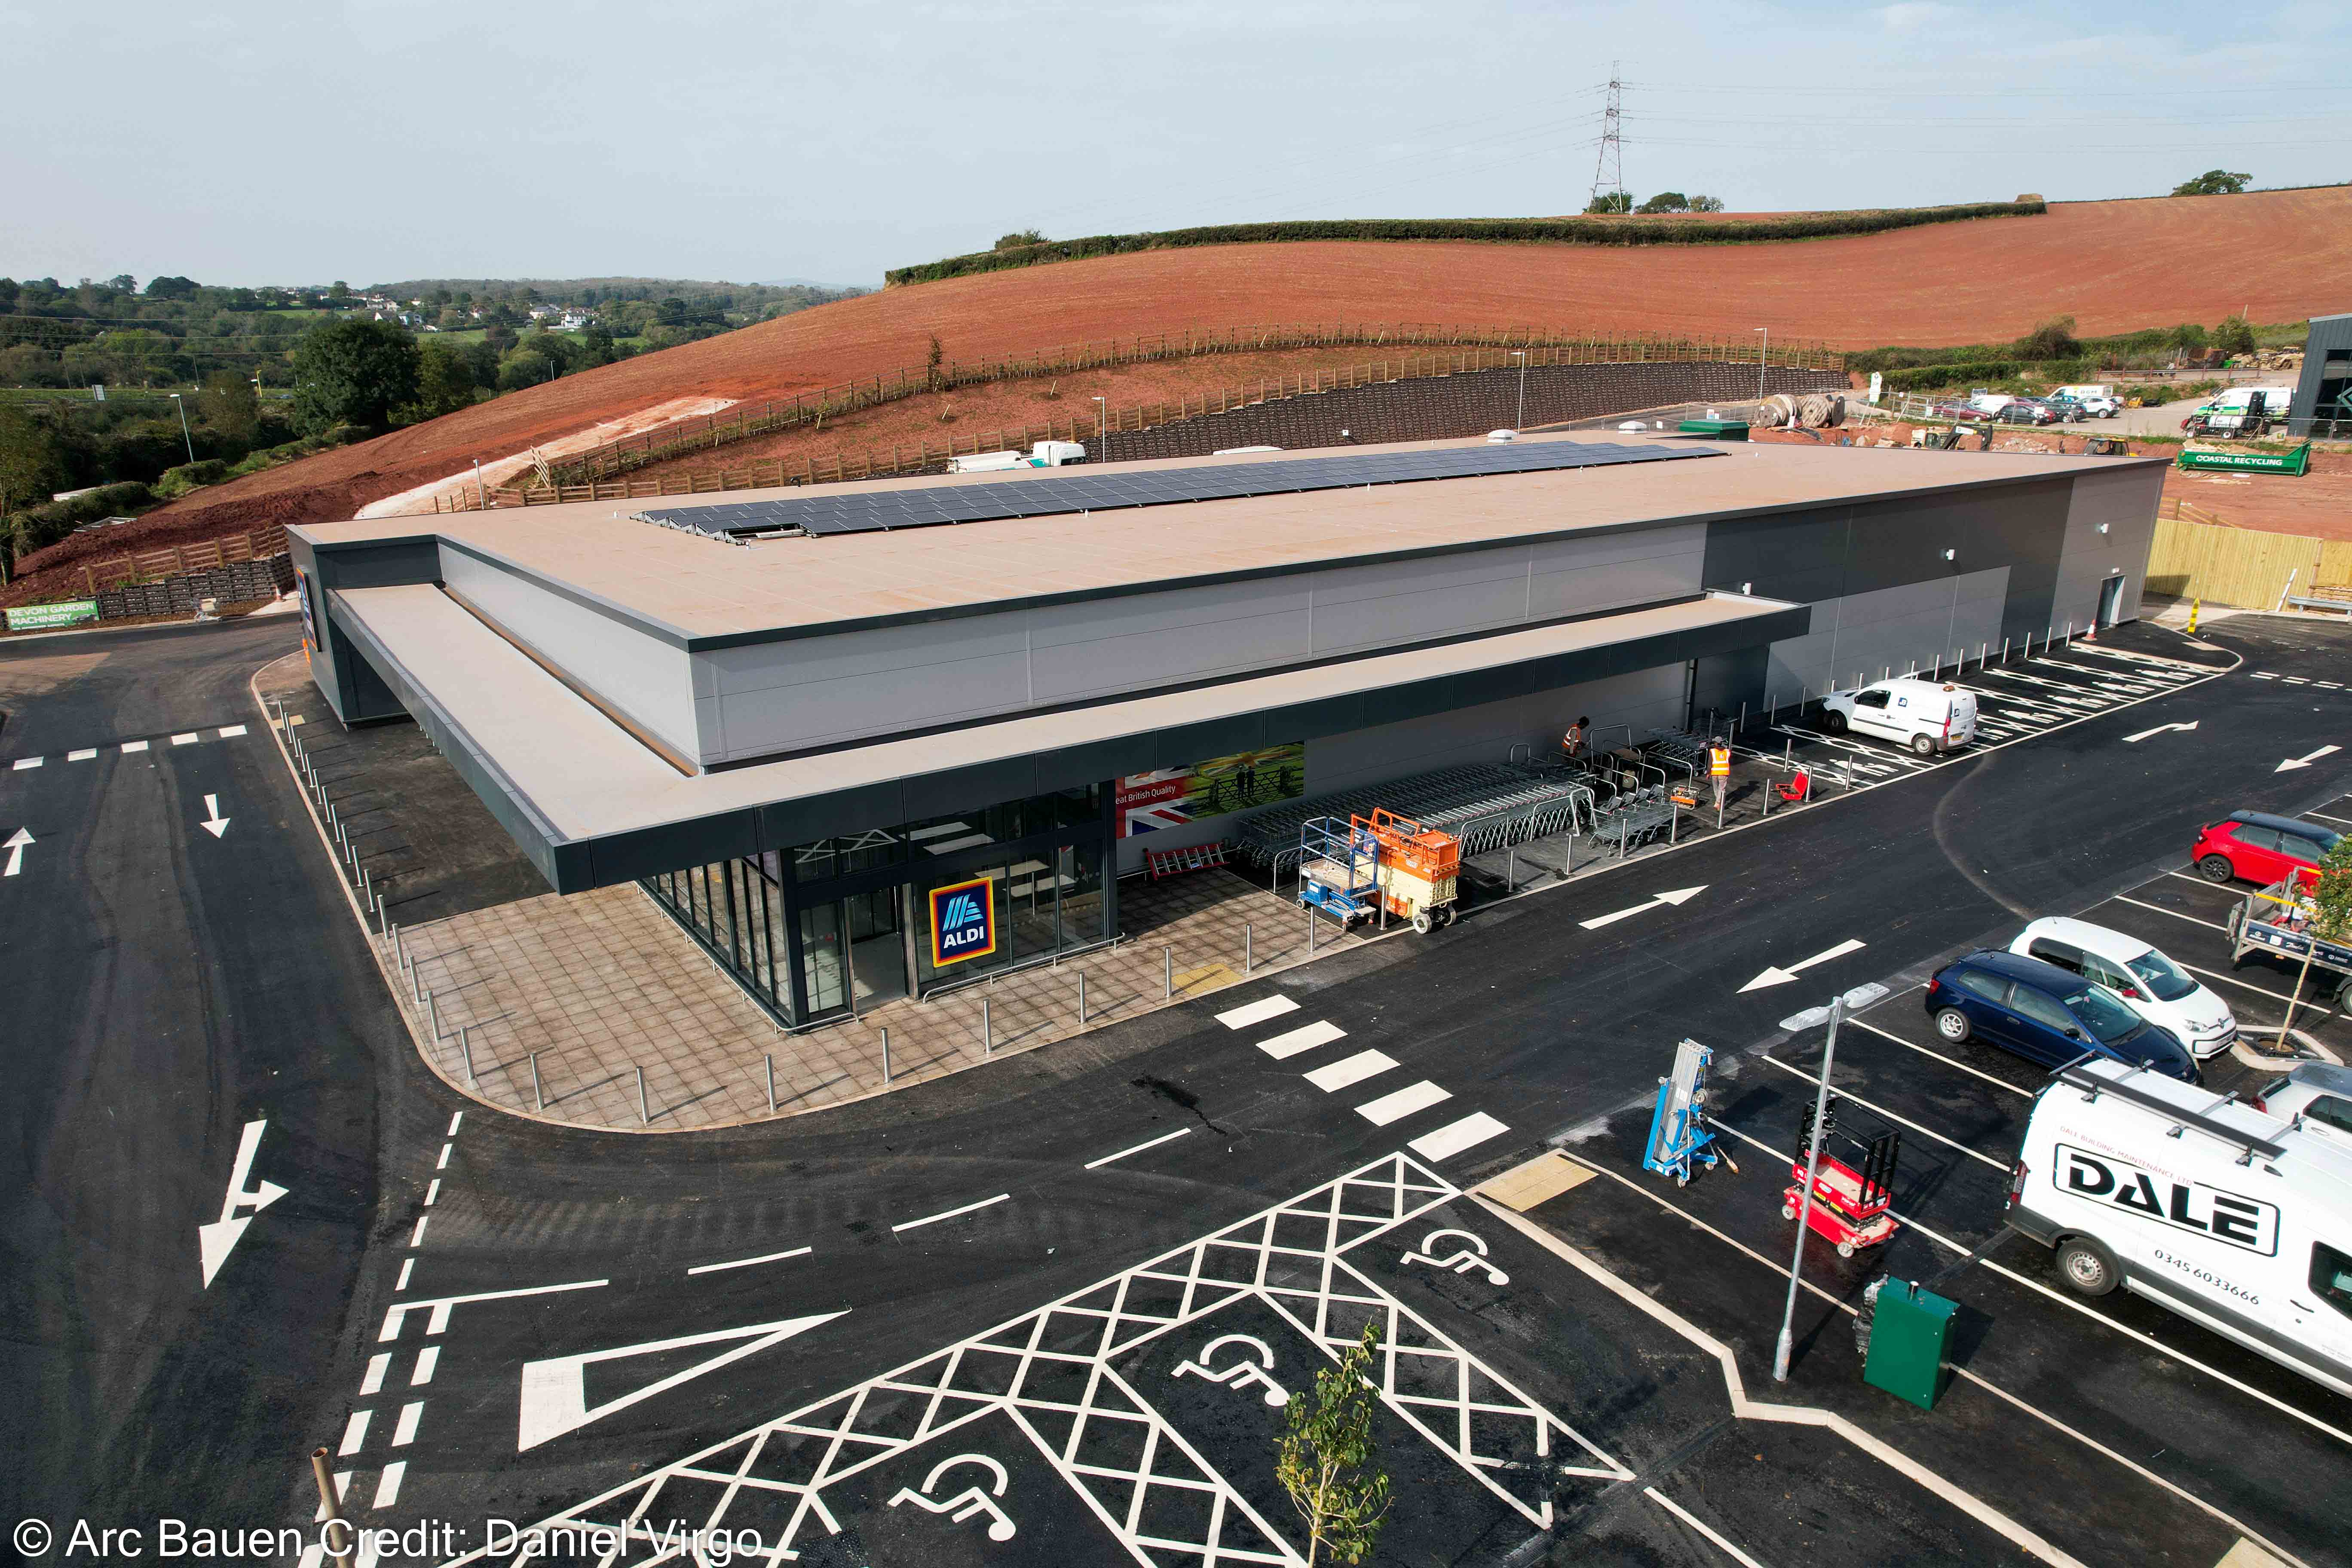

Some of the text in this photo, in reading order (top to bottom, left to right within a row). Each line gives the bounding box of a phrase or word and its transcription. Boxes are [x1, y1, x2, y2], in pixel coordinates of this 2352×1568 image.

[2196, 455, 2283, 466] COASTAL RECYCLING
[9, 602, 94, 617] DEVON GARDEN
[10, 613, 72, 625] MACHINERY
[1115, 785, 1176, 804] eat British Quality
[943, 926, 984, 949] ALDI
[2060, 1126, 2193, 1186] DALE BUILDING MAINTENANCE LTD
[2069, 1153, 2259, 1246] DALE
[2155, 1250, 2259, 1305] 0345 6033666
